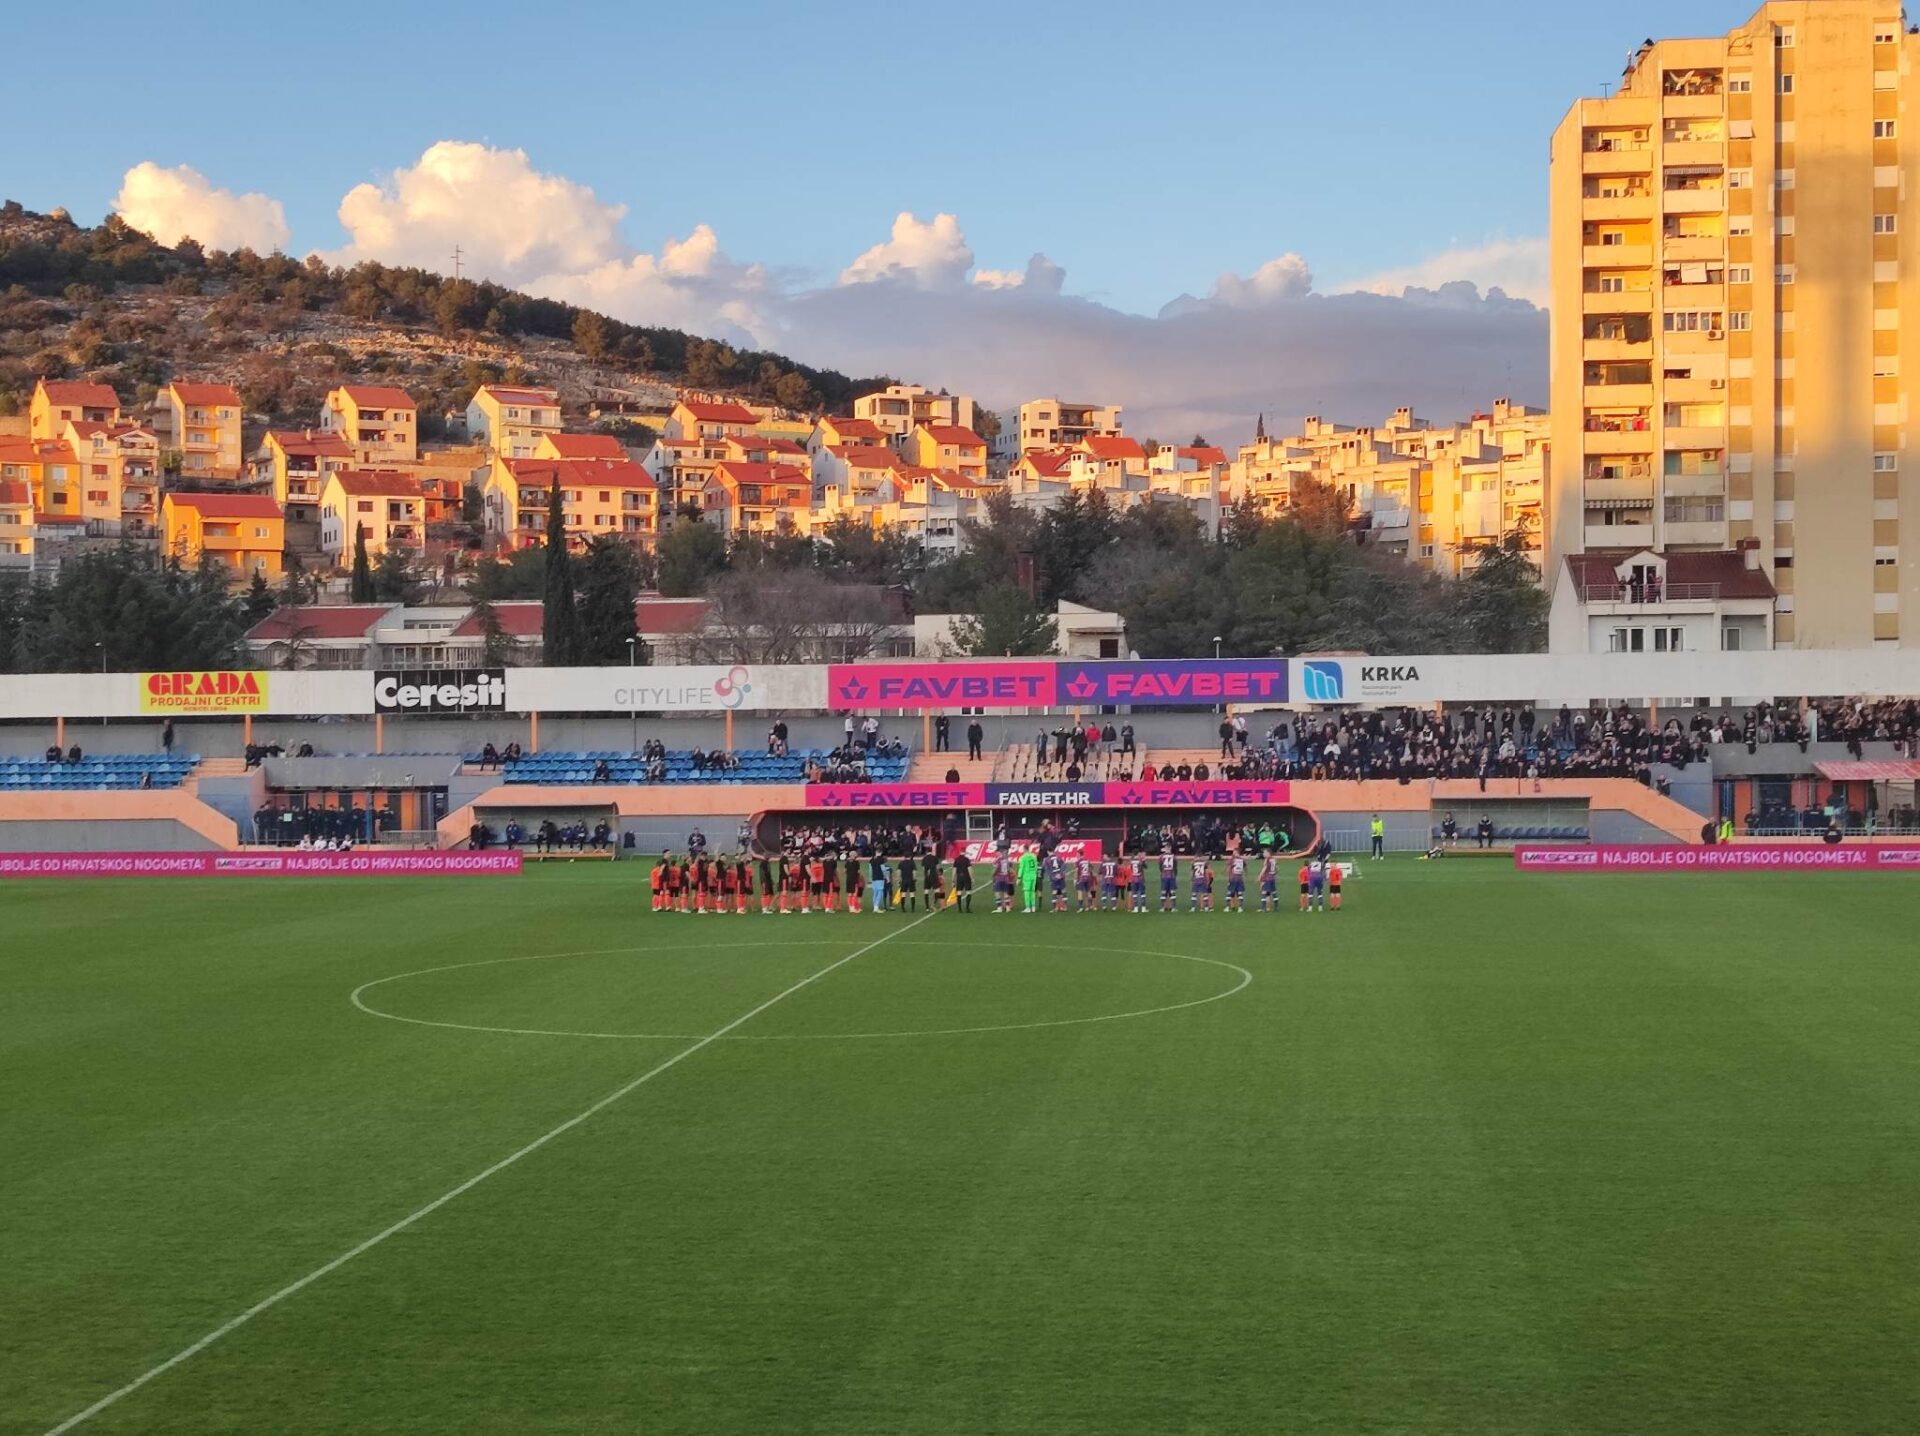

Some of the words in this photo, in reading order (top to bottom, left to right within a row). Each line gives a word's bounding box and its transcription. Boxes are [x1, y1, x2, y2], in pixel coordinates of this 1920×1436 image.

[1361, 666, 1419, 681] KRKA
[375, 673, 505, 708] Ceresit
[879, 676, 1046, 699] FAVBET
[1107, 672, 1279, 697] FAVBET
[150, 696, 211, 707] PRODAJNI
[215, 695, 260, 705] CENTRI
[614, 687, 712, 705] CITYLIFE
[851, 791, 969, 806] FAVBET
[999, 791, 1090, 805] FAVBET.HR
[1150, 789, 1275, 804] FAVBET
[42, 859, 59, 871] OD
[62, 858, 132, 871] HRVATSKOG
[134, 858, 205, 870] NOGOMETA!
[287, 857, 349, 869] NAJBOLJE
[352, 857, 369, 869] OD
[371, 856, 443, 869] HRVATSKOG
[445, 856, 518, 868] NOGOMETA!
[1603, 852, 1673, 864] NAJBOLJE
[1676, 852, 1696, 864] OD
[1700, 851, 1780, 864] HRVATSKOG
[1783, 851, 1866, 863] NOGOMETA!
